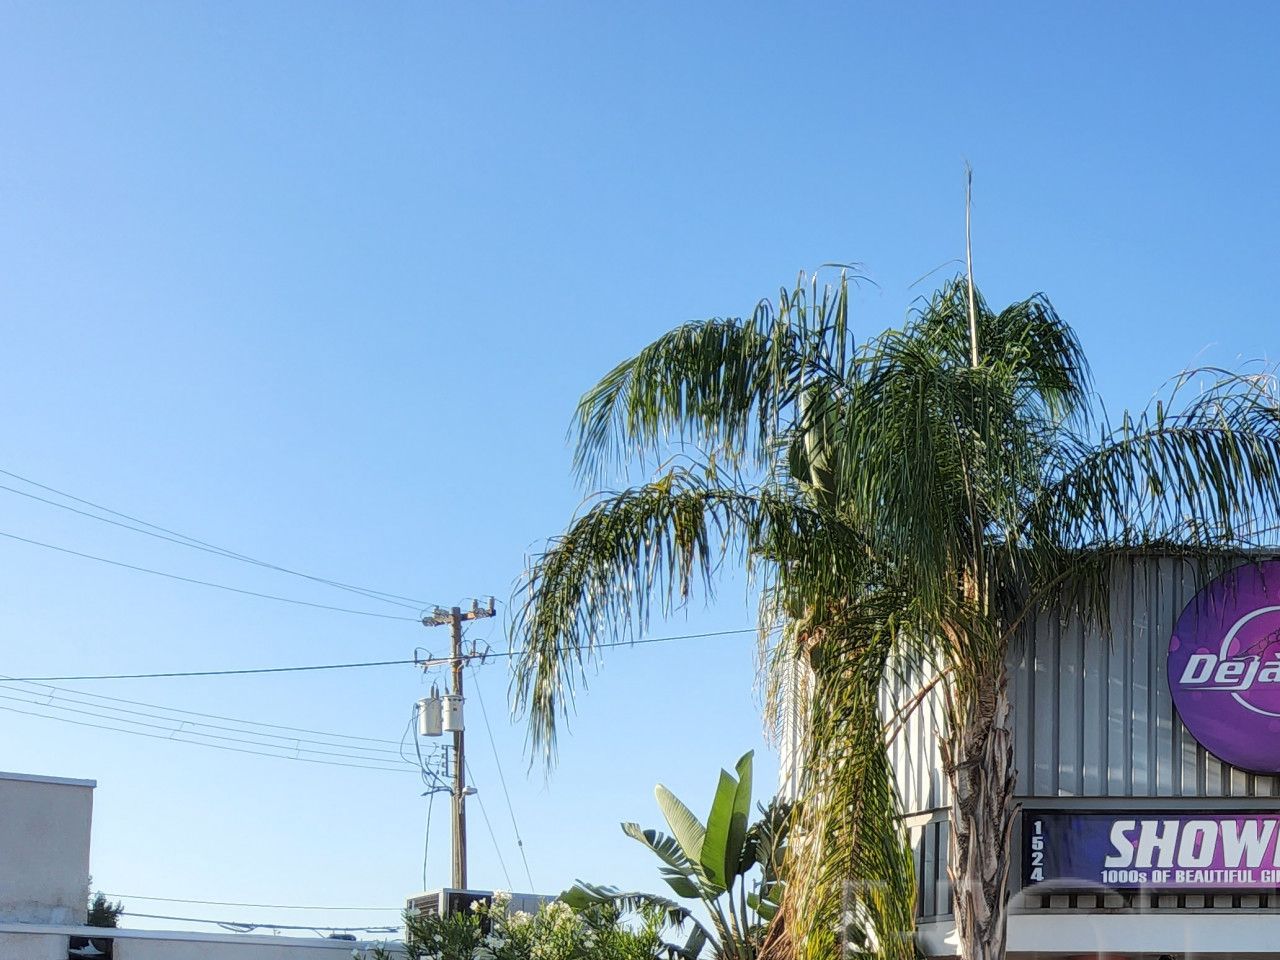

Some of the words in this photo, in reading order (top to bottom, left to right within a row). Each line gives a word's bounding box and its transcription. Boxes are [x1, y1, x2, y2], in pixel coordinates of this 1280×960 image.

[1030, 820, 1045, 882] 1524
[1101, 869, 1148, 884] 1000s
[1151, 869, 1173, 884] OF
[1175, 869, 1257, 884] BEAUTIFUL
